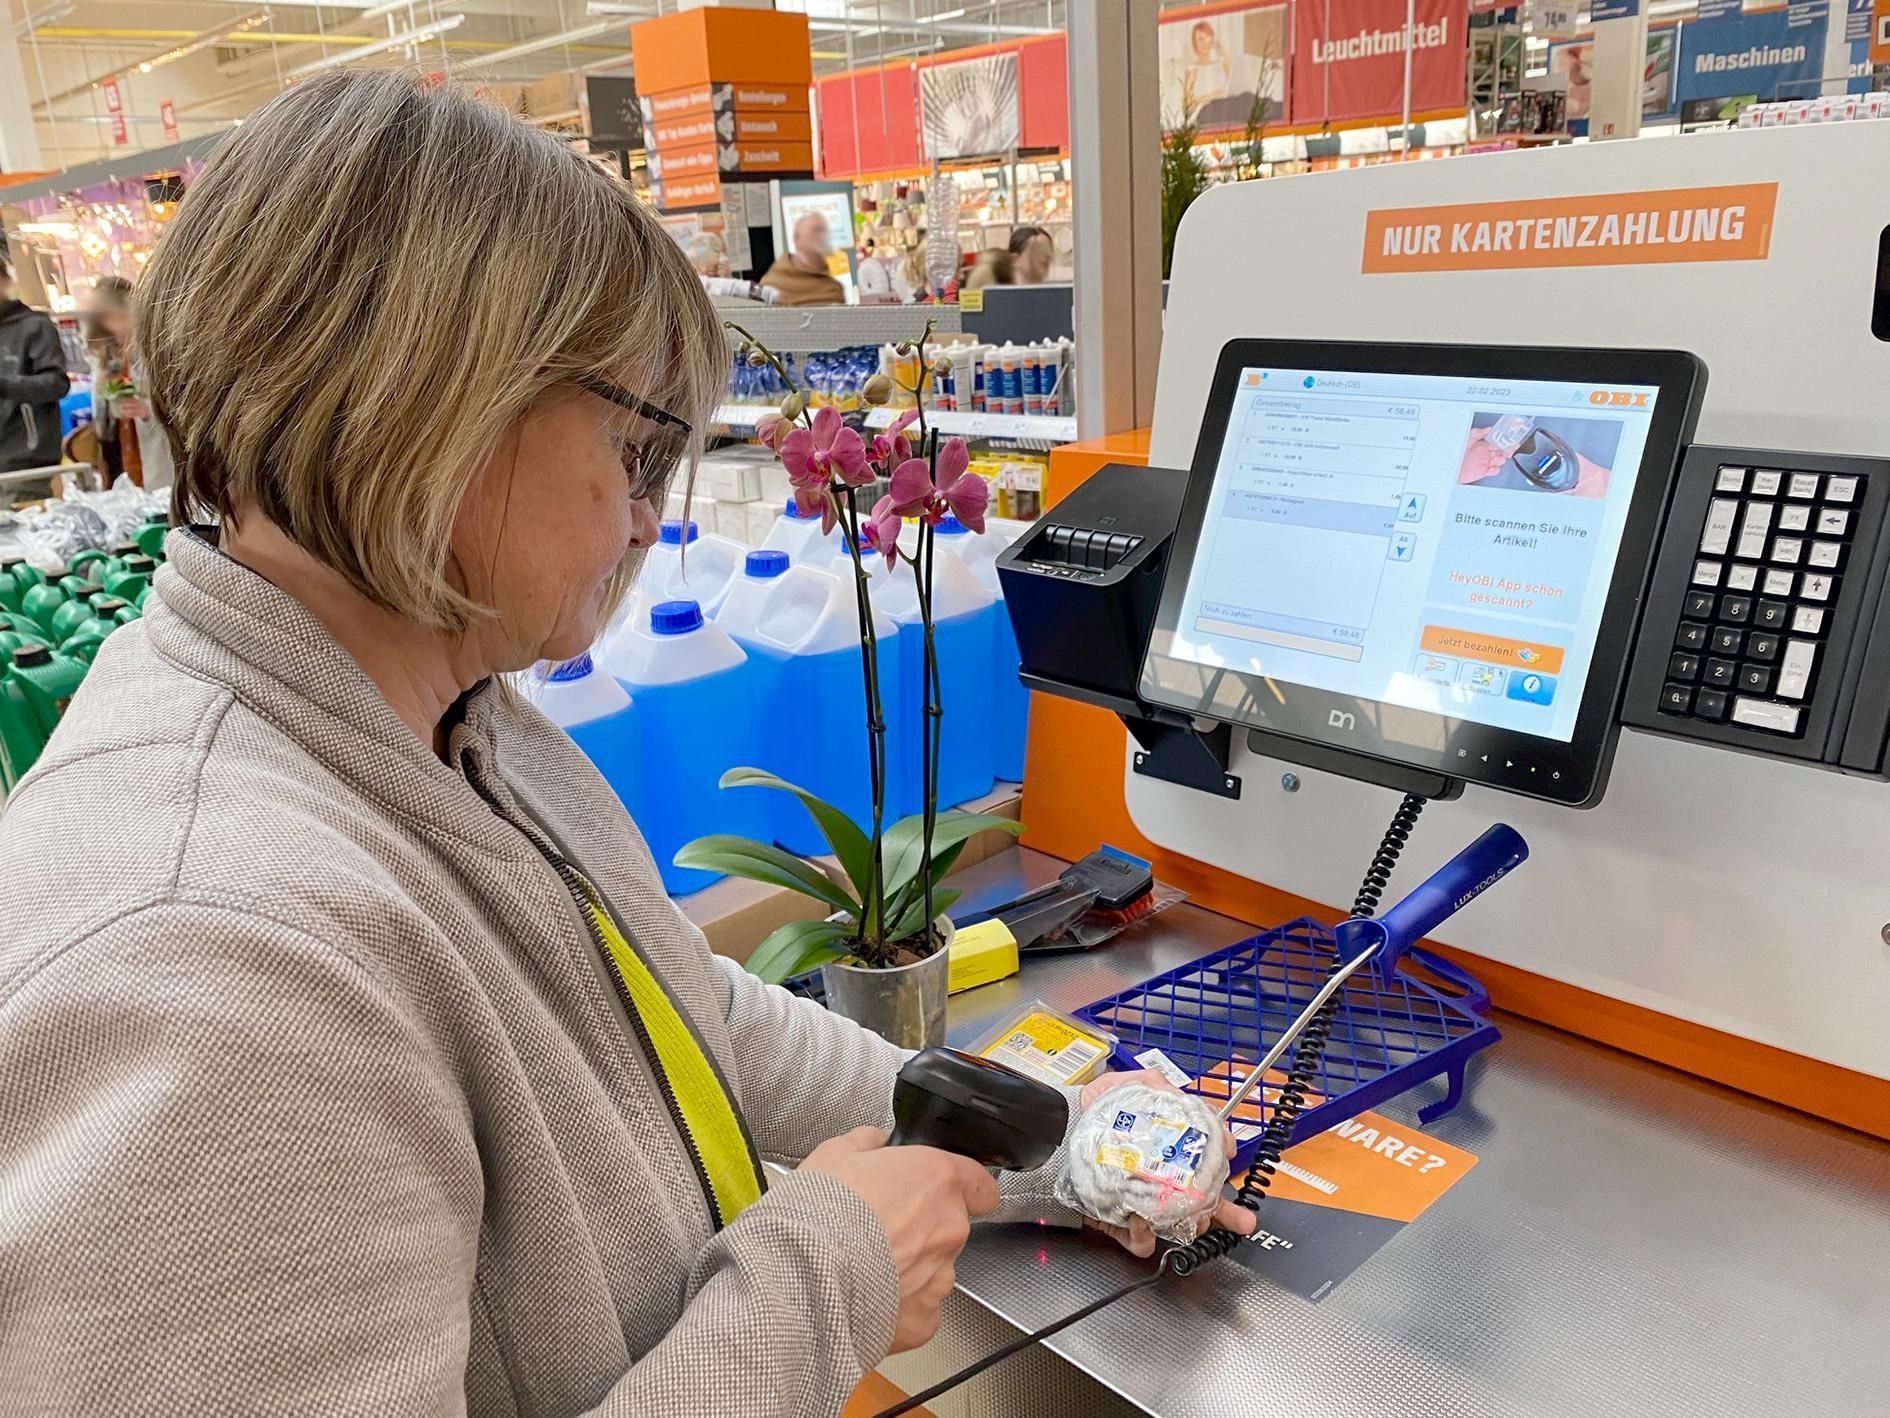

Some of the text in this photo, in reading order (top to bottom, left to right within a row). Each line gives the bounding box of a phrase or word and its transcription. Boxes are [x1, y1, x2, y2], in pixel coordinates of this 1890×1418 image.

[1312, 17, 1448, 64] Leuchtmittel
[1695, 44, 1806, 74] Maschinen
[1382, 225, 1441, 256] NUR
[1450, 206, 1746, 253] KARTENZAHLUNG
[1589, 390, 1650, 408] OBI
[1455, 513, 1588, 538] Bitte scannen Sie Ihre
[1493, 534, 1538, 549] Artikel!
[1449, 571, 1563, 597] HeyOBI App schon
[1469, 591, 1534, 609] gescannt?
[1695, 599, 1704, 610] 7
[1731, 604, 1740, 615] 8
[1765, 609, 1775, 620] 9
[1687, 630, 1696, 640] 4
[1722, 636, 1731, 646] 5
[1437, 635, 1514, 657] Jetzt bezahlen!
[1758, 642, 1767, 652] 6
[1681, 661, 1688, 671] 1
[1714, 666, 1724, 677] 2
[1750, 673, 1759, 684] 3
[1454, 867, 1504, 910] LUX-TOOLS
